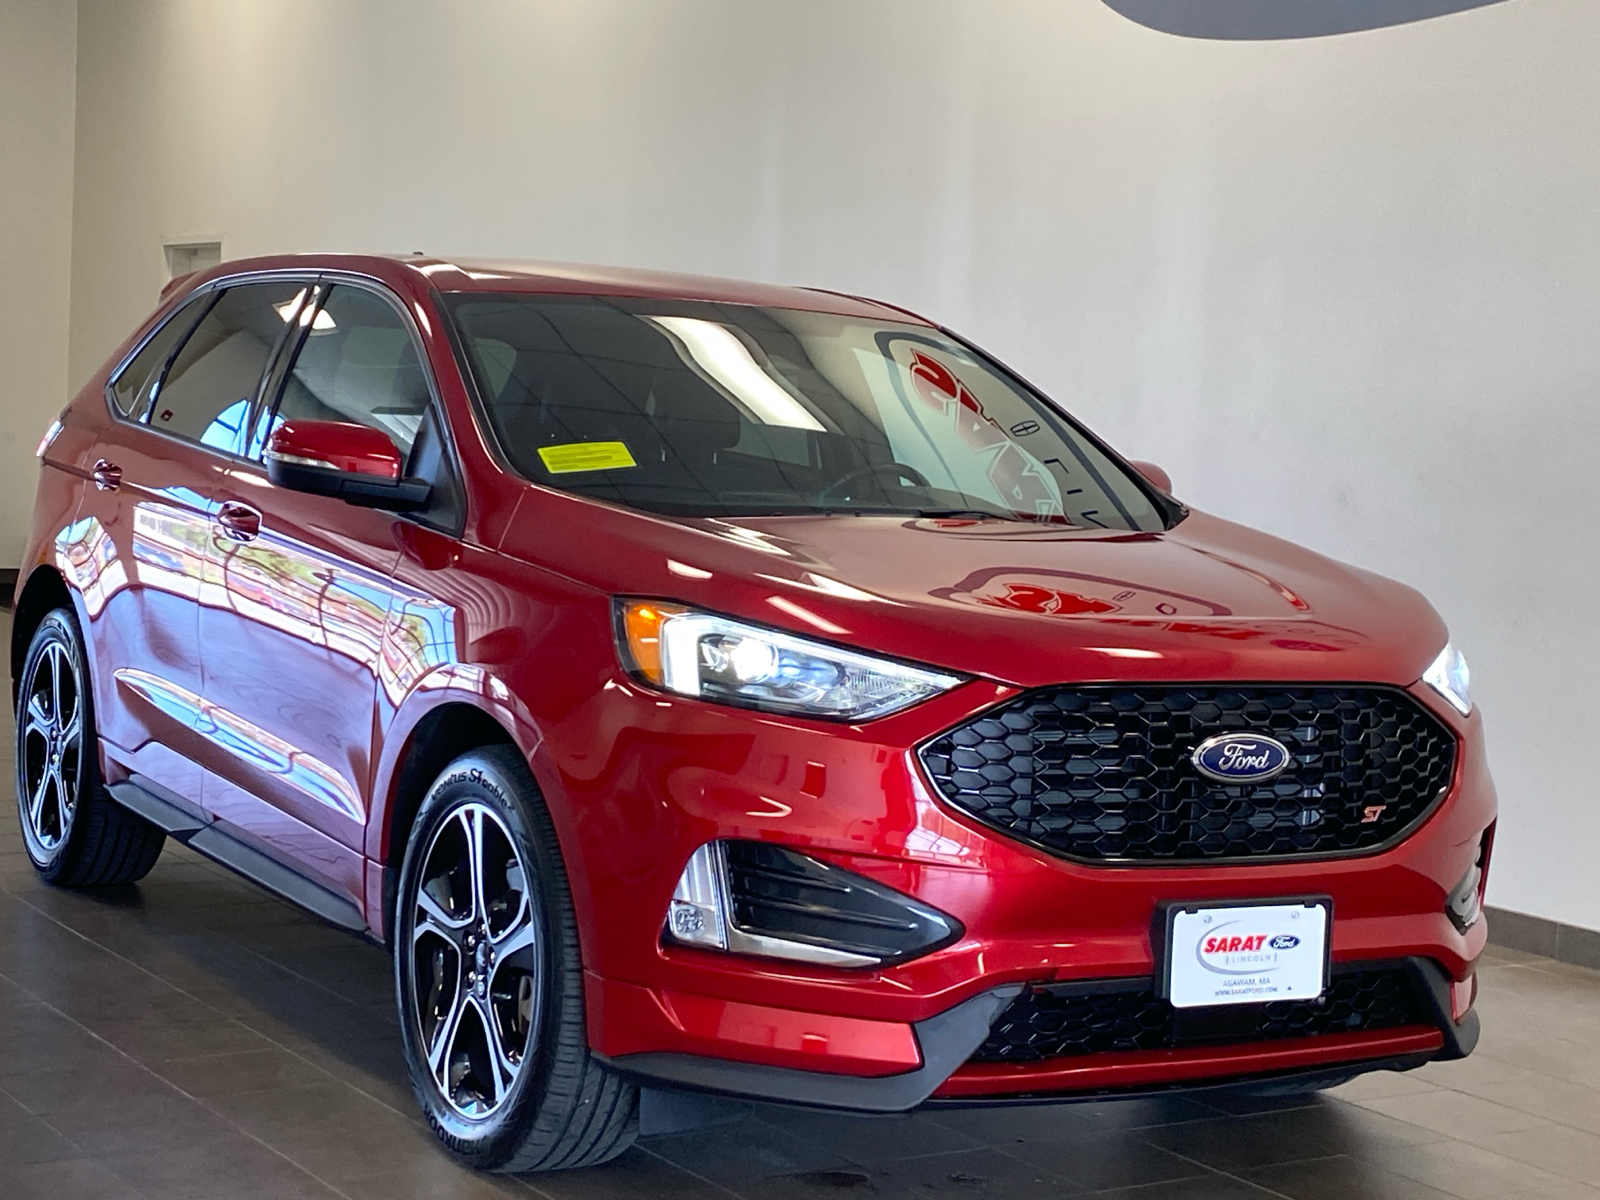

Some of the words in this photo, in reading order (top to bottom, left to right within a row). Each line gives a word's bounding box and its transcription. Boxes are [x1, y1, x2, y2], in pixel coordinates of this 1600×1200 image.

[1219, 743, 1270, 771] Ford
[1360, 805, 1387, 823] ST
[1203, 934, 1268, 954] SARAT
[1272, 935, 1296, 949] Ford
[1231, 954, 1272, 964] LINCOLN
[1222, 978, 1258, 987] AGAWAM,
[1258, 977, 1271, 986] MA
